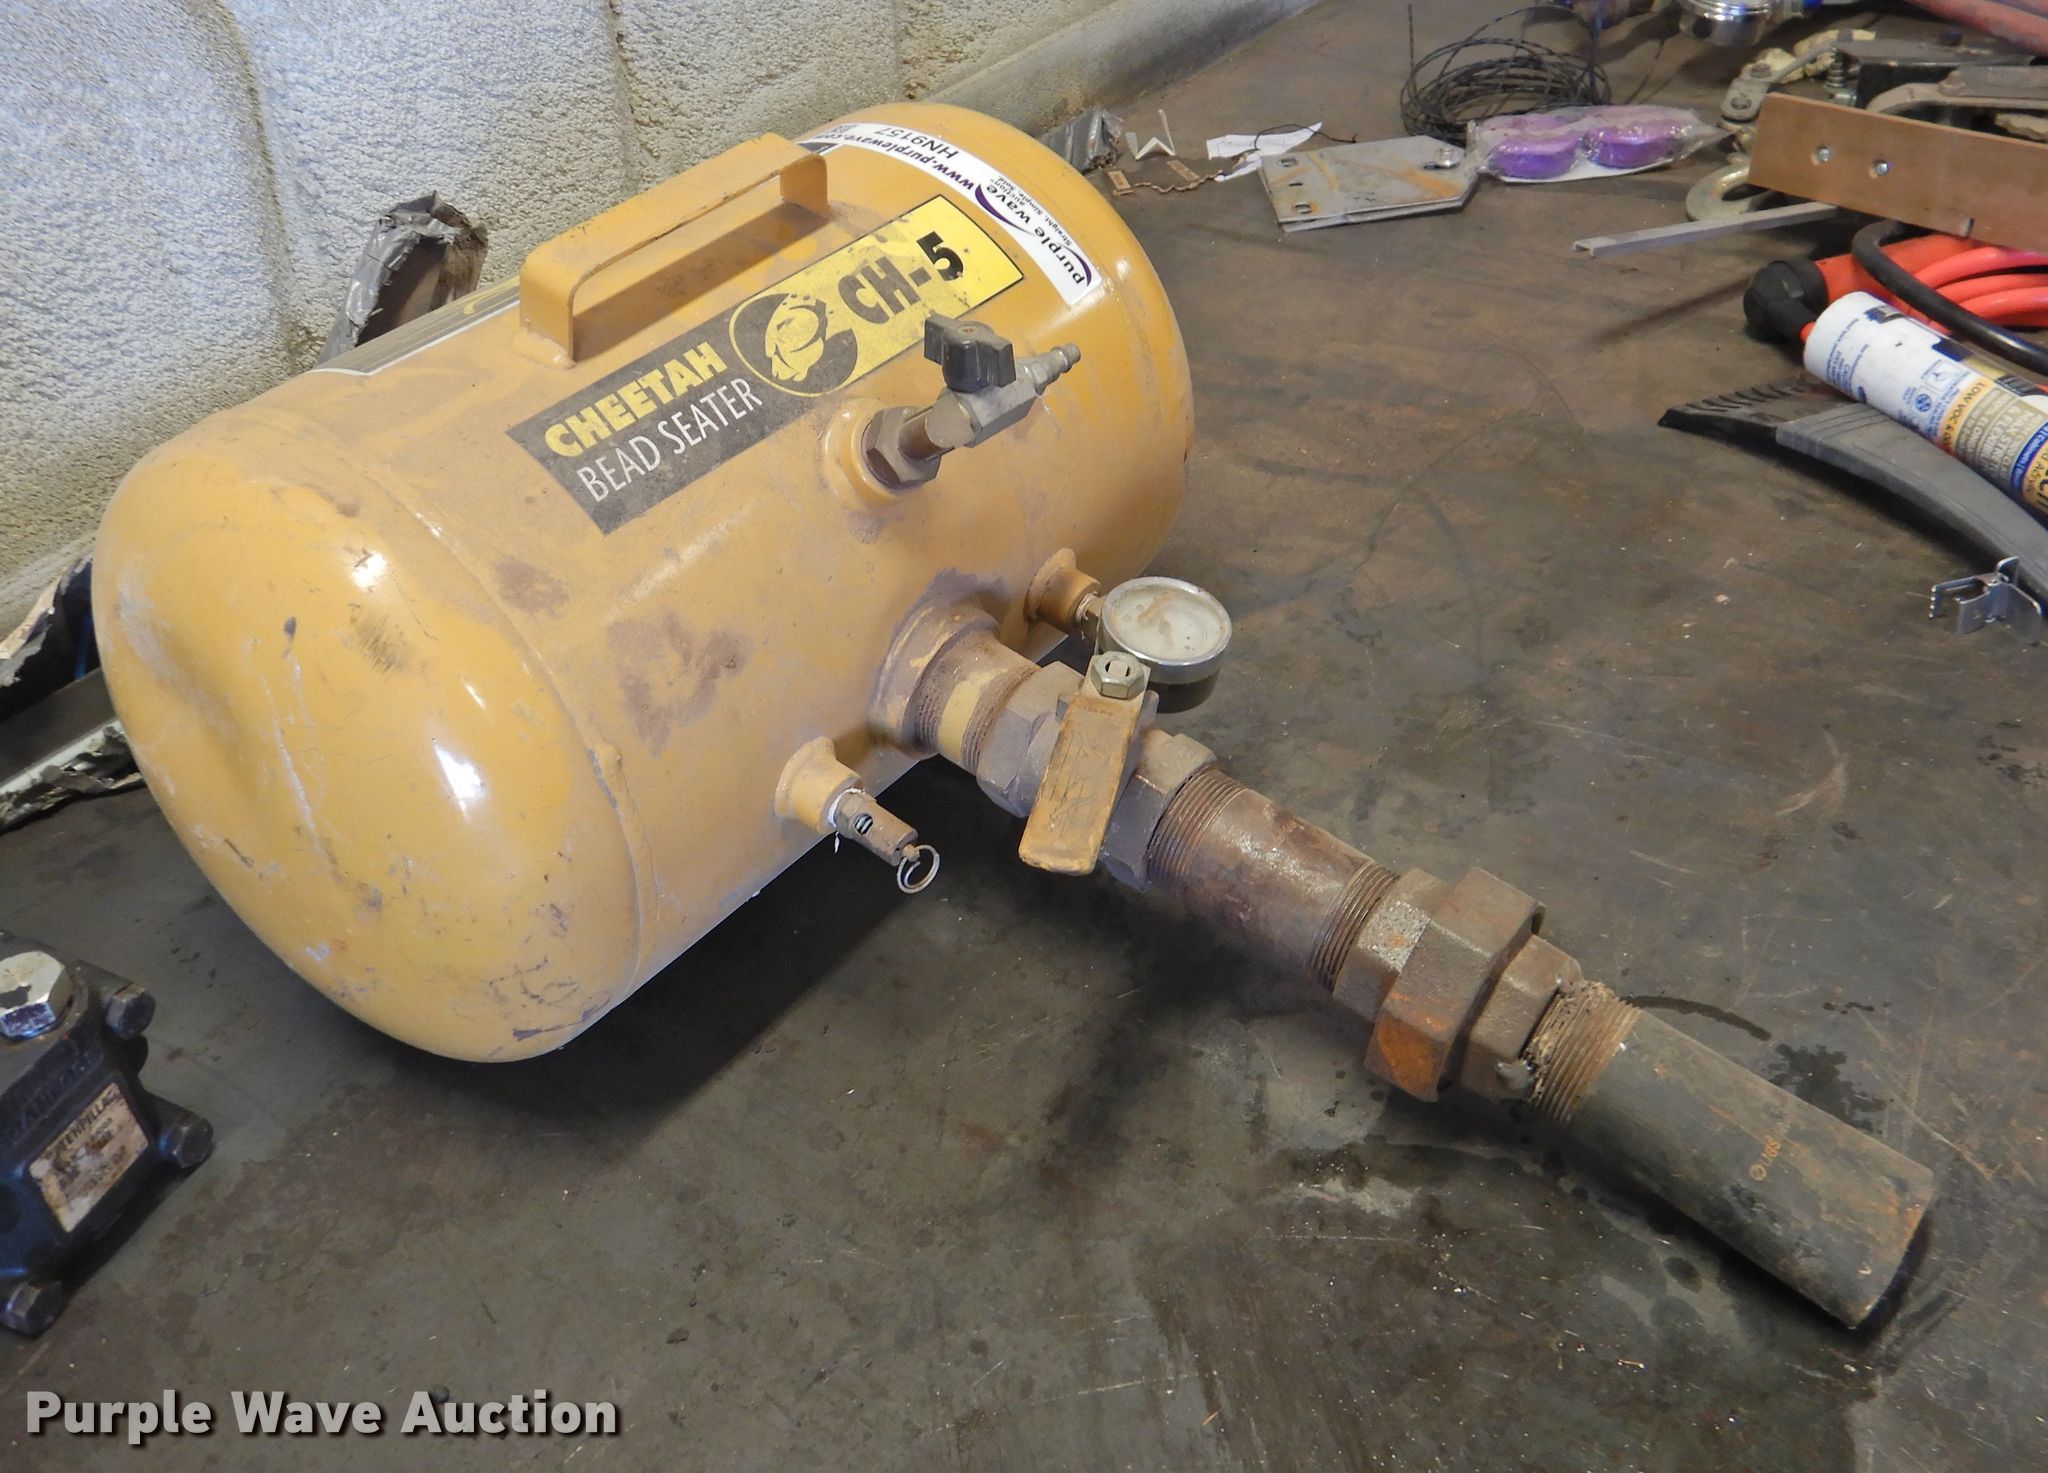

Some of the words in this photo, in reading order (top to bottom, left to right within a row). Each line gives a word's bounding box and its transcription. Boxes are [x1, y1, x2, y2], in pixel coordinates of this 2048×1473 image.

[874, 127, 959, 158] HN9157
[986, 185, 1031, 224] wave
[838, 231, 964, 324] CH-5
[1034, 226, 1086, 284] purple
[545, 341, 728, 457] CHEETAH
[577, 435, 661, 502] BEAD
[657, 378, 763, 455] SEATER
